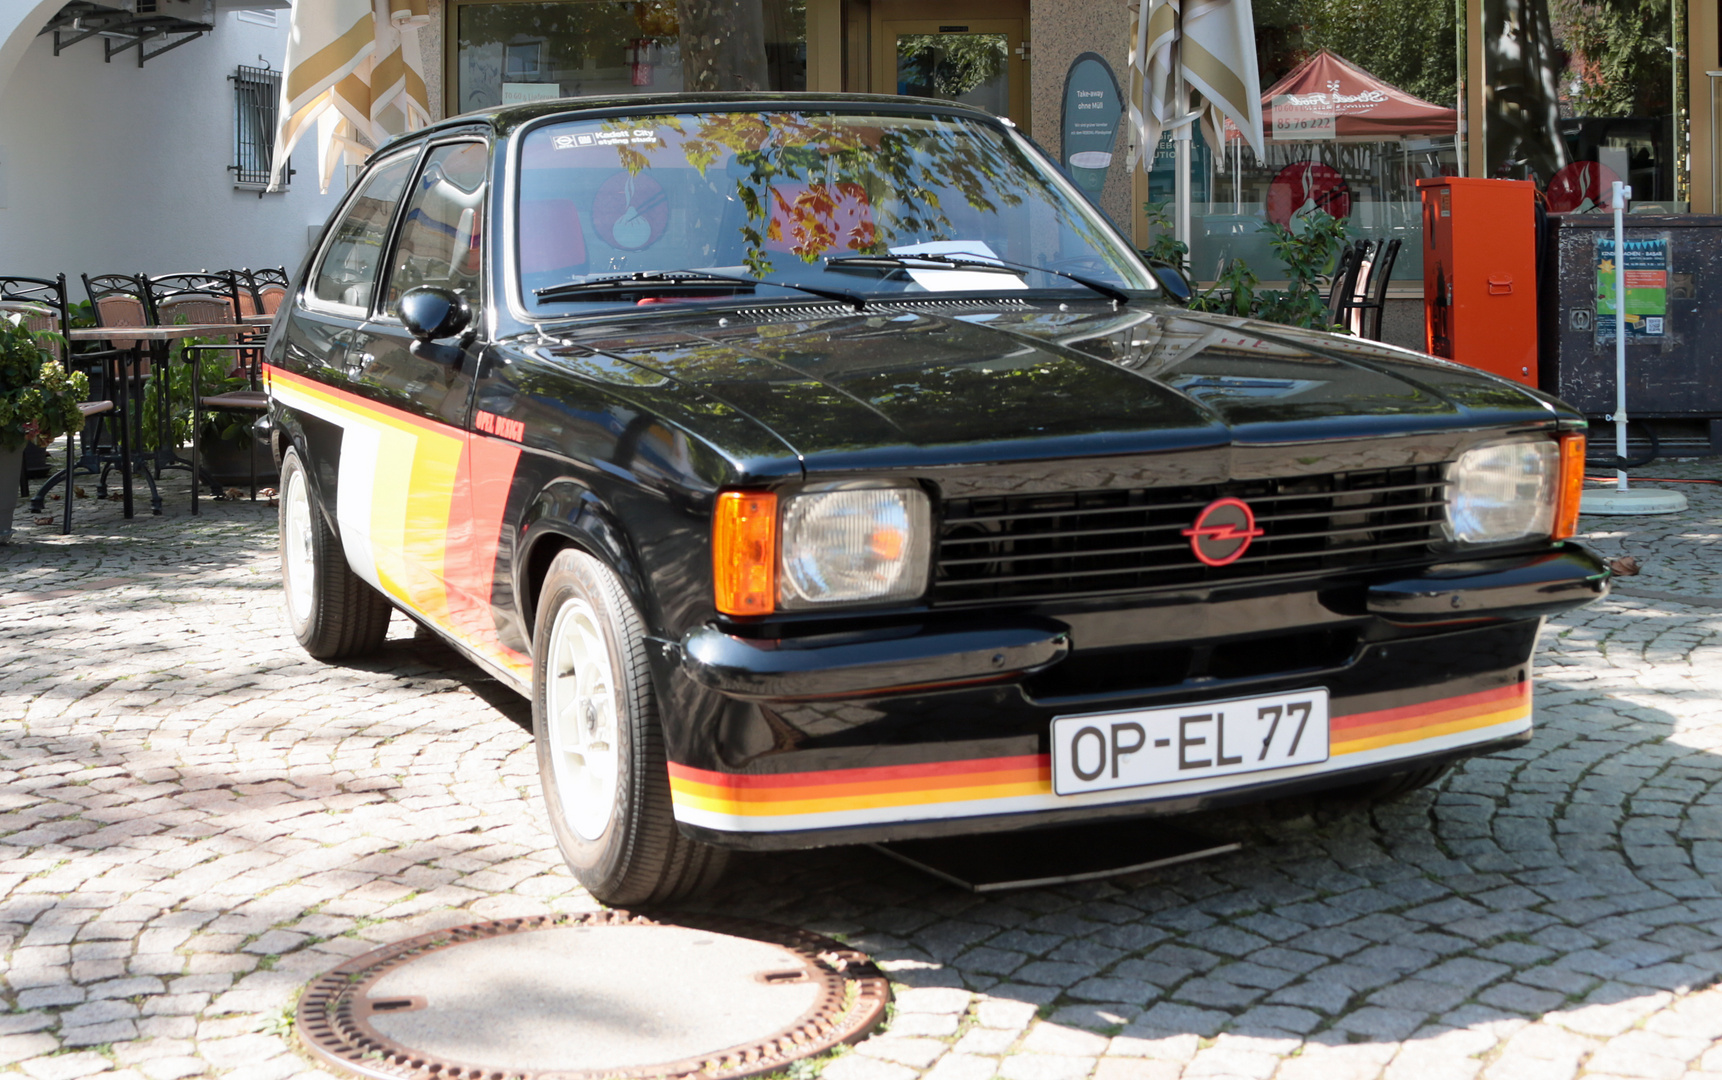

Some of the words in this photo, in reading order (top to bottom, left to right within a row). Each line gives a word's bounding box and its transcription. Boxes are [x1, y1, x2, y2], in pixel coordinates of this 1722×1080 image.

[1077, 91, 1104, 99] Take-away
[1078, 102, 1091, 110] ohne
[1277, 118, 1291, 129] 85
[1293, 118, 1308, 129] 76
[1310, 117, 1331, 129] 222
[595, 130, 630, 139] Kadett
[633, 129, 654, 137] City
[598, 138, 629, 146] styling
[475, 410, 495, 434] OPEL
[1070, 712, 1243, 782] OP-EL
[1257, 701, 1313, 761] 77
